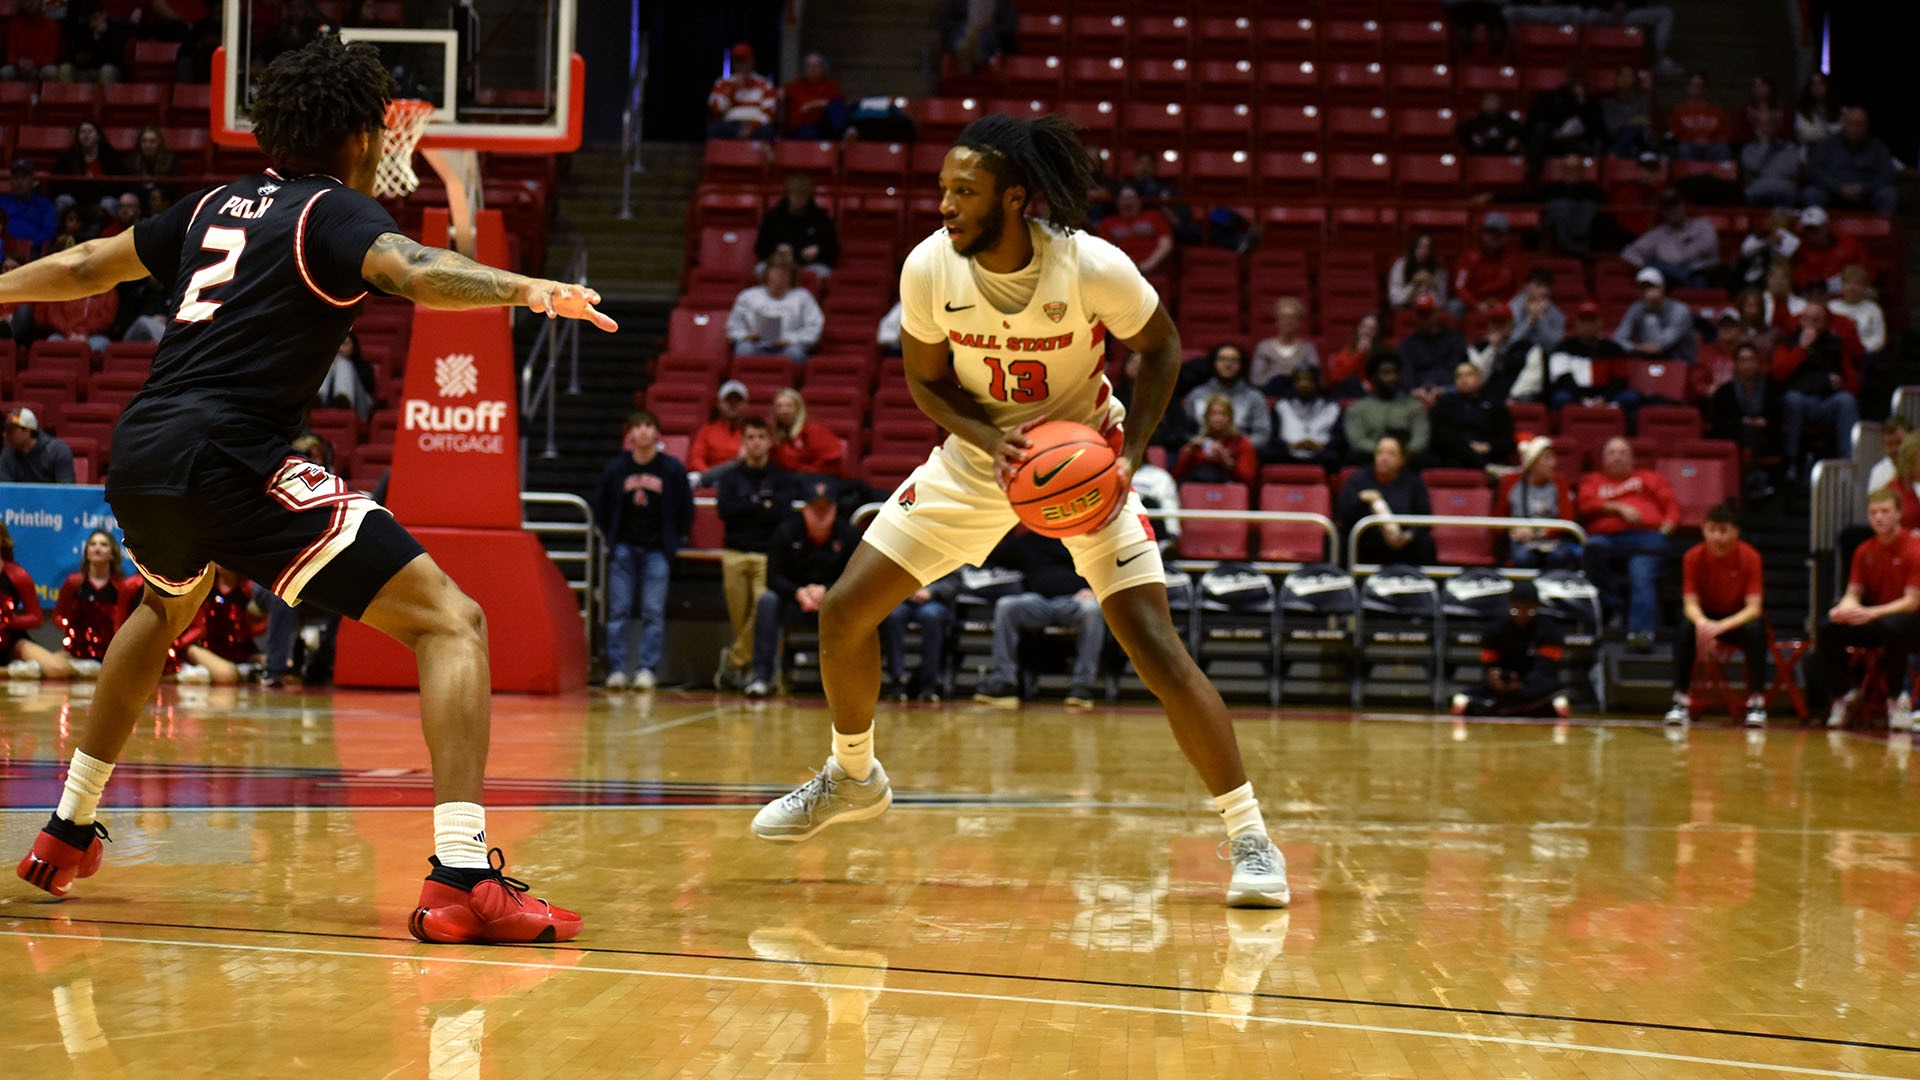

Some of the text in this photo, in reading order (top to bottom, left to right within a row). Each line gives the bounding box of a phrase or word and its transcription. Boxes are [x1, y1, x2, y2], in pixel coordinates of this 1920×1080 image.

[174, 224, 248, 324] 2
[949, 330, 1074, 352] BALL STATE
[983, 356, 1049, 404] 13
[405, 400, 507, 432] Ruoff
[5, 508, 63, 532] Printing
[1041, 487, 1102, 523] ELITE
